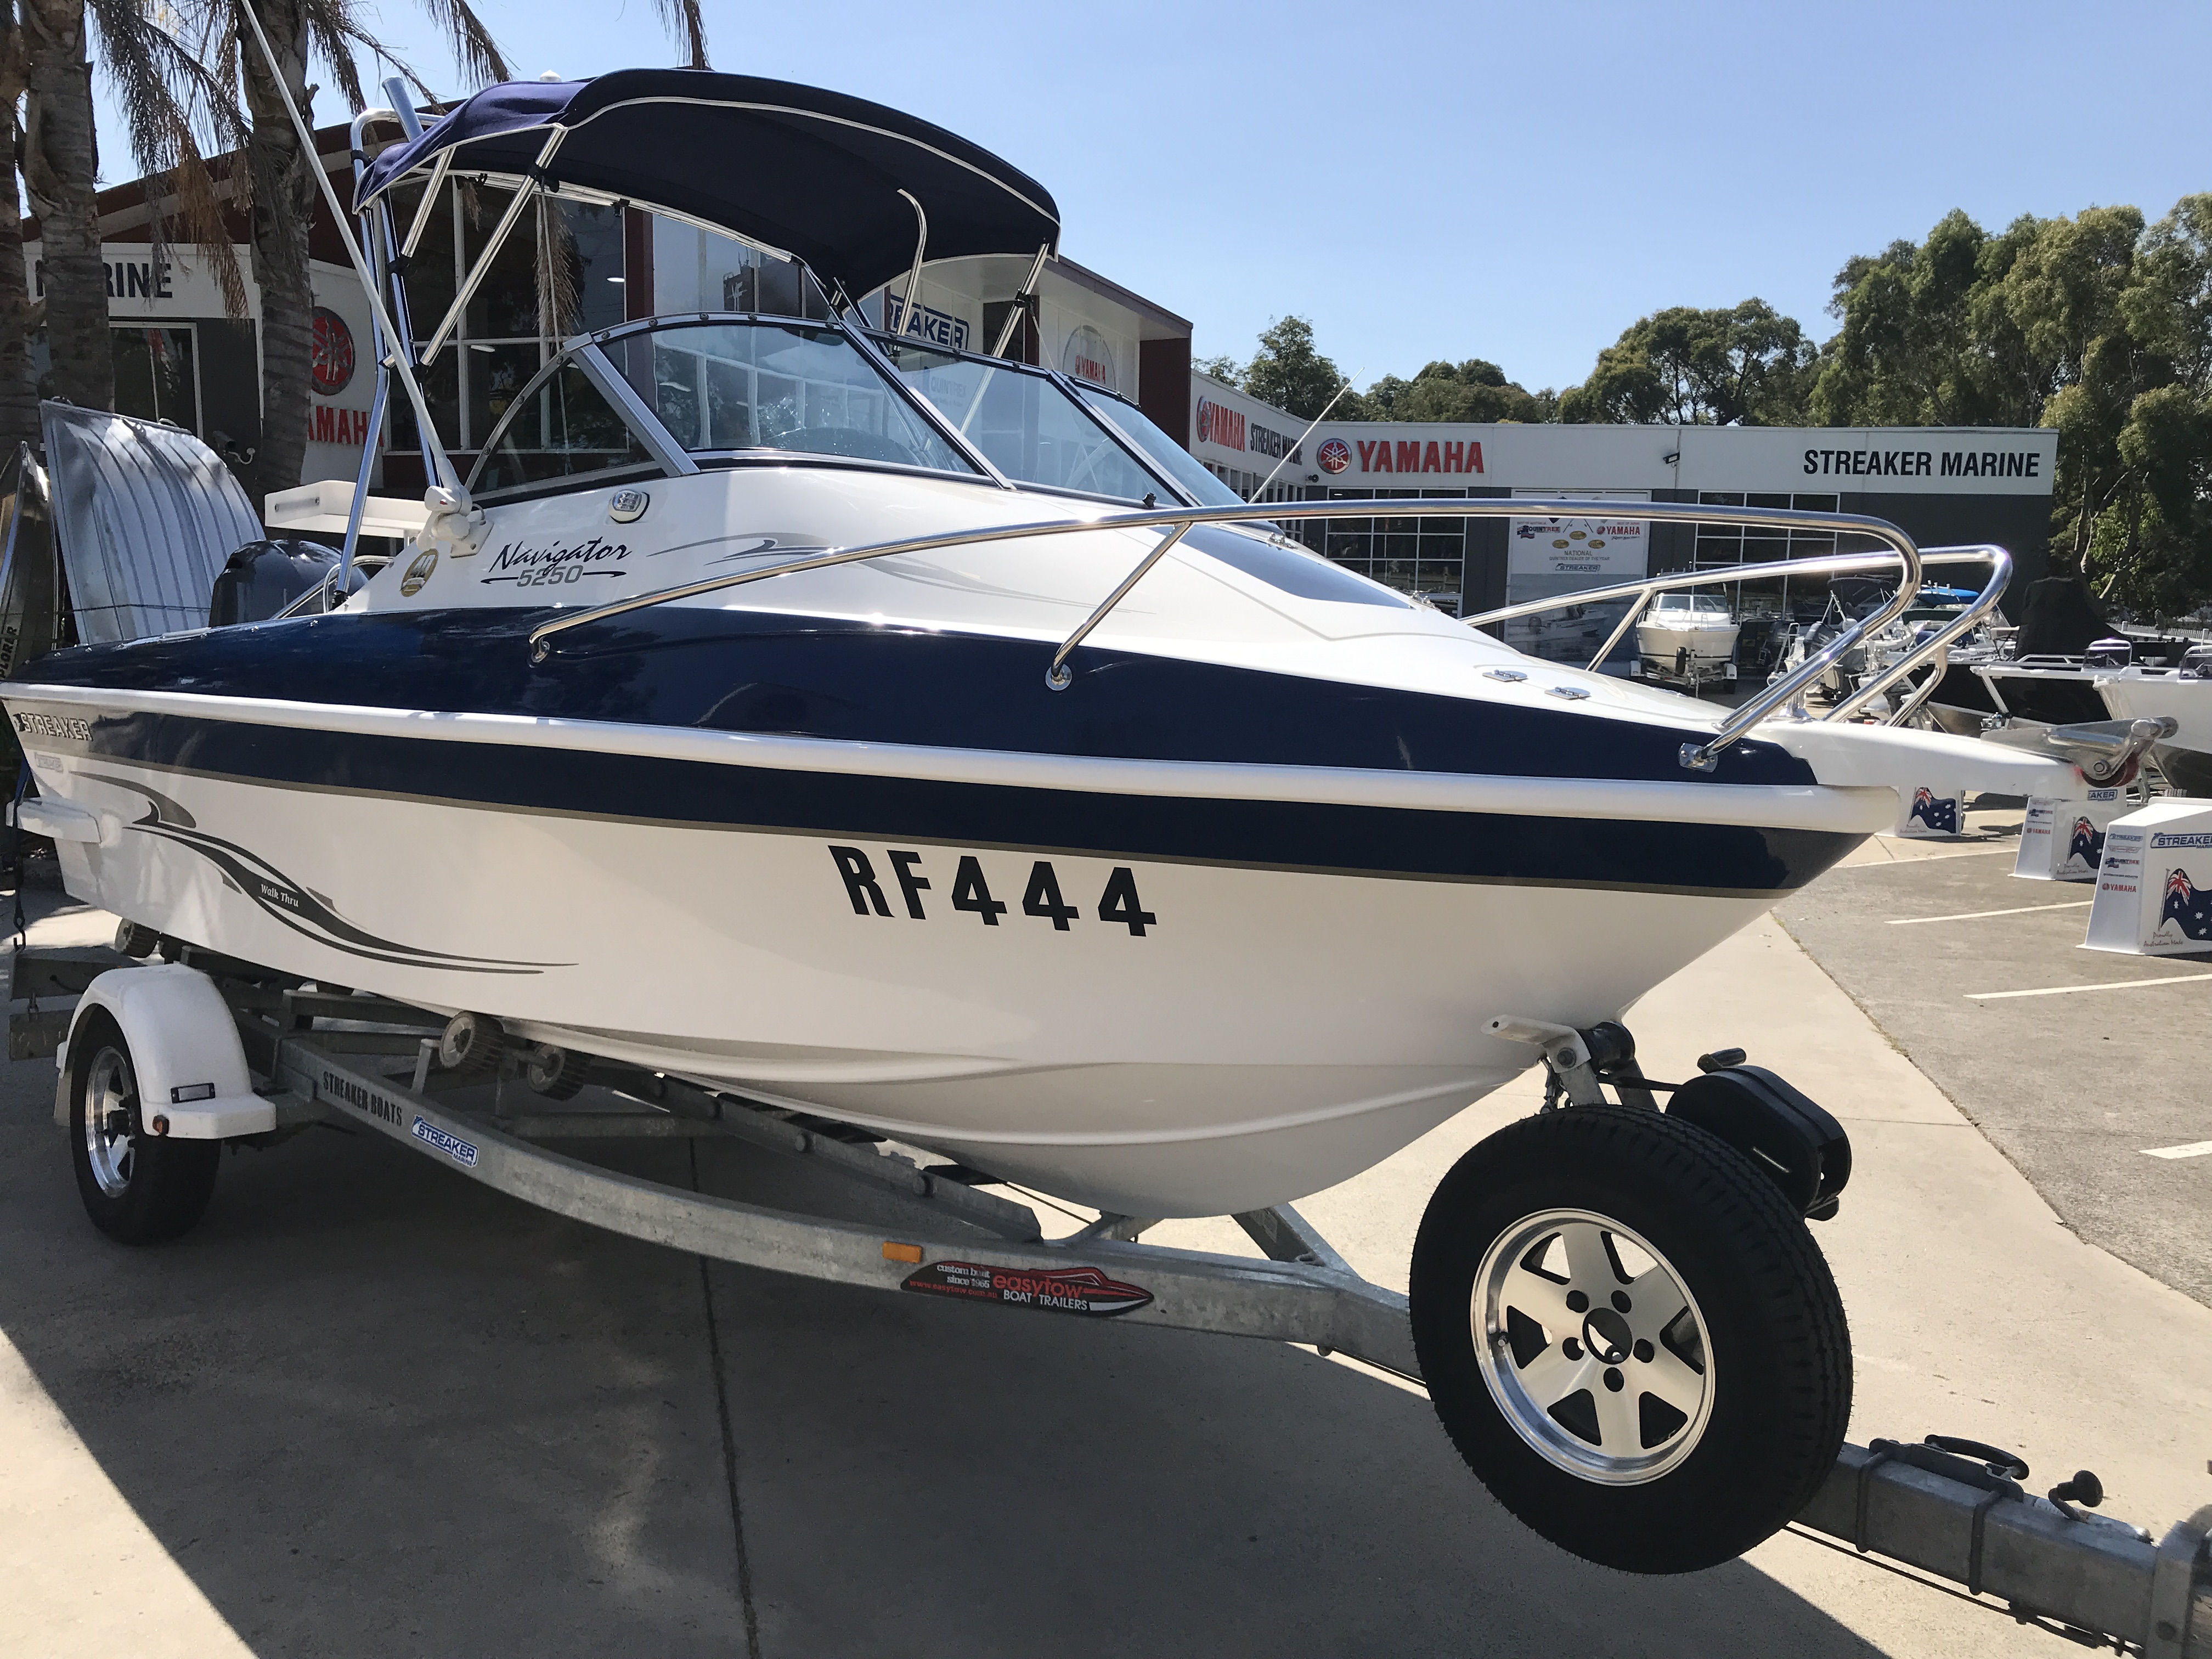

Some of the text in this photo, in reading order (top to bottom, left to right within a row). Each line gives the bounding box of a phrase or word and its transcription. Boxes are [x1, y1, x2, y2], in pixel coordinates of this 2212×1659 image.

[1209, 401, 1245, 453] YAMAHA
[1250, 422, 1282, 460] STREAKER
[1357, 441, 1485, 473] YAMAHA
[1803, 449, 2040, 477] STREAKER MARINE
[1606, 526, 1640, 535] YAMAHA
[488, 537, 632, 576] Navigator
[517, 565, 584, 587] 5250
[20, 712, 94, 742] STREAKER
[2158, 836, 2212, 846] STREAKE
[261, 884, 298, 907] Walk Thru
[2110, 883, 2137, 893] YAMAHA
[323, 1071, 402, 1126] STREAKER BOATS
[417, 1124, 475, 1161] STREAKER
[453, 1154, 473, 1167] MARINE
[936, 1263, 969, 1276] custom
[946, 1274, 970, 1286] since
[909, 1279, 997, 1299] www.easytow.com.au
[992, 1274, 1083, 1299] easytow
[1003, 1289, 1088, 1311] BOAT TRAILERS
